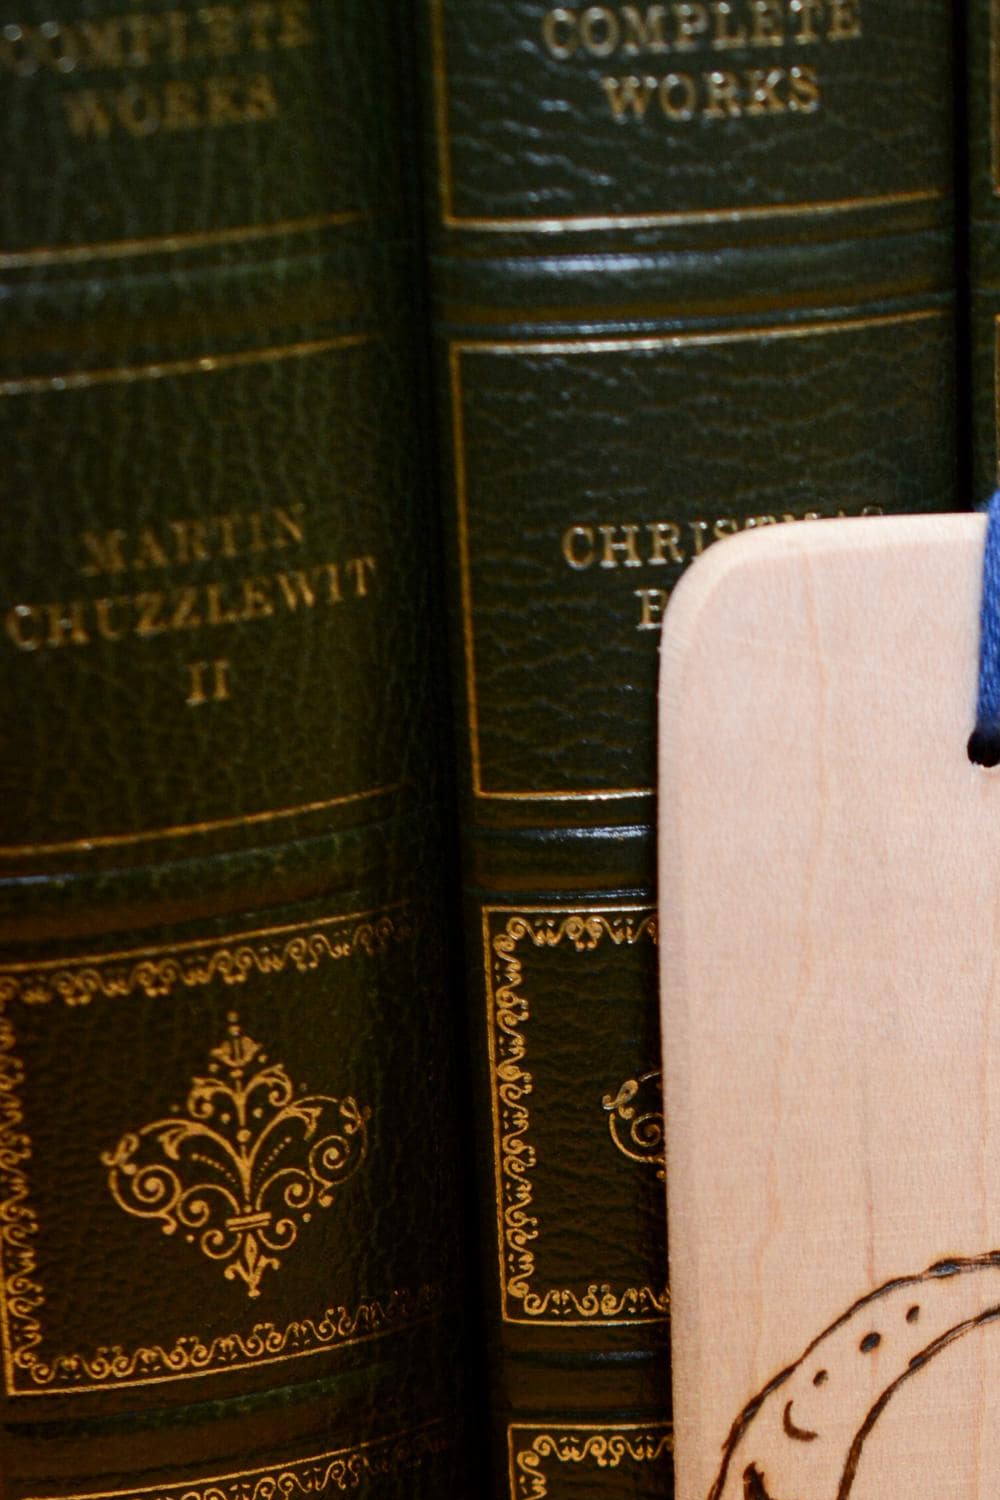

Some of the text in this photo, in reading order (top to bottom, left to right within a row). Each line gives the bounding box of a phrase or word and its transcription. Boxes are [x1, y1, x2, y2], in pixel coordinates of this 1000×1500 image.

[542, 0, 862, 59] COMPLETE
[603, 64, 819, 124] WORKS
[80, 501, 305, 577] MARTIN
[5, 555, 376, 652] CHUZZLEWIT
[185, 657, 231, 706] II
